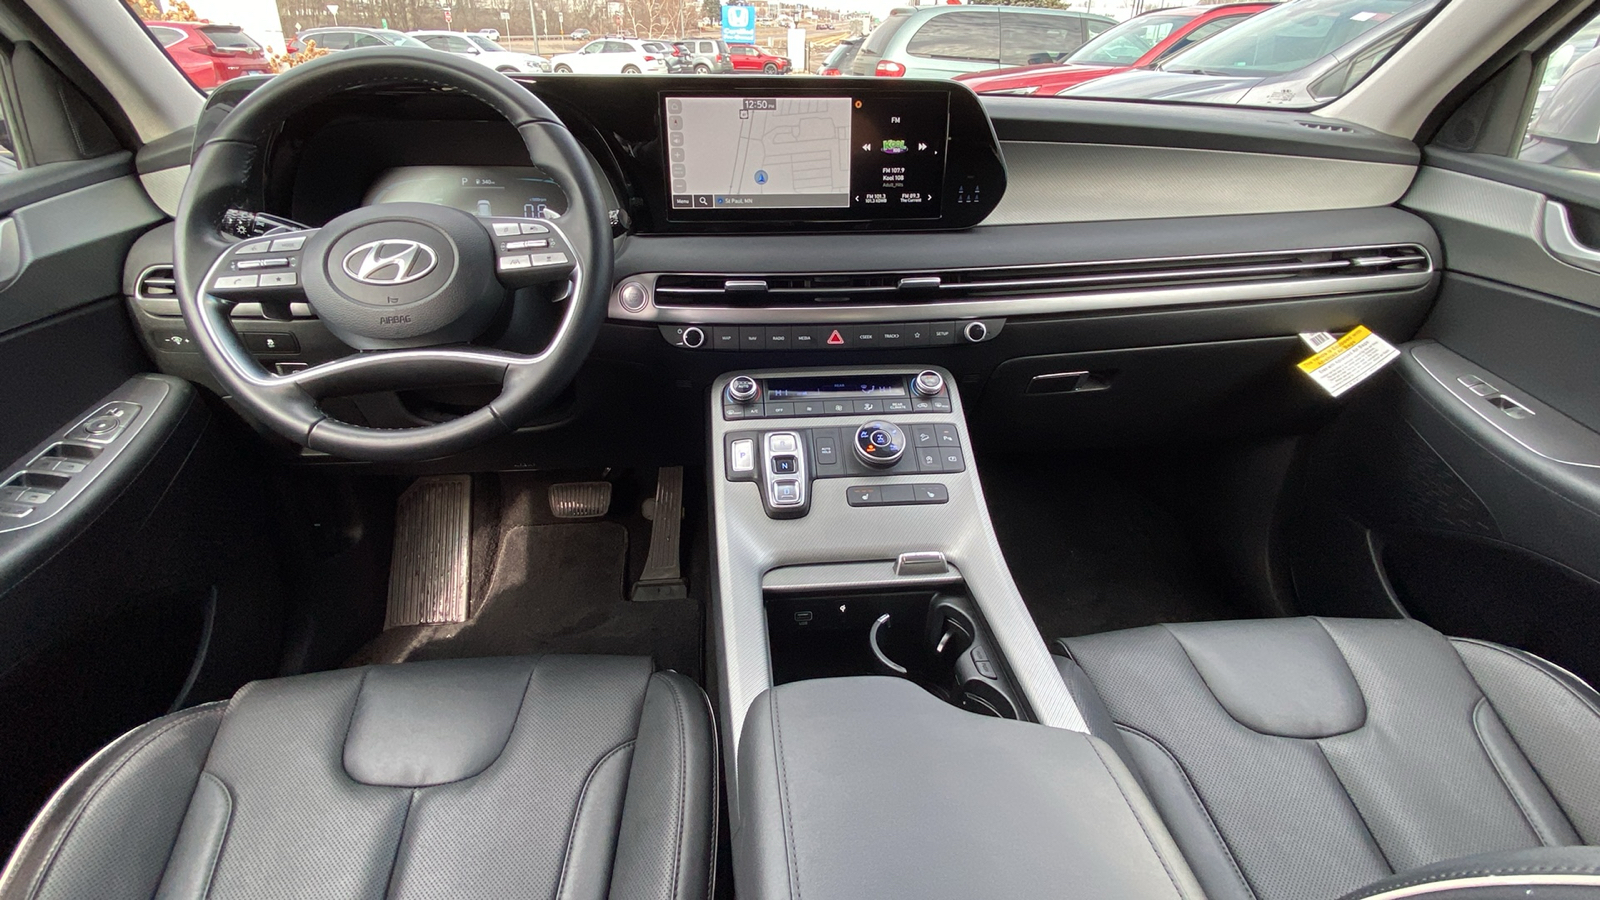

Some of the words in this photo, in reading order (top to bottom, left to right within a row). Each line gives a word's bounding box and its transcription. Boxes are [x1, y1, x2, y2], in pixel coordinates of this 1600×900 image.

[745, 100, 768, 109] 12:50
[891, 116, 901, 124] FM
[462, 177, 468, 186] P
[380, 315, 412, 325] AIRBAG
